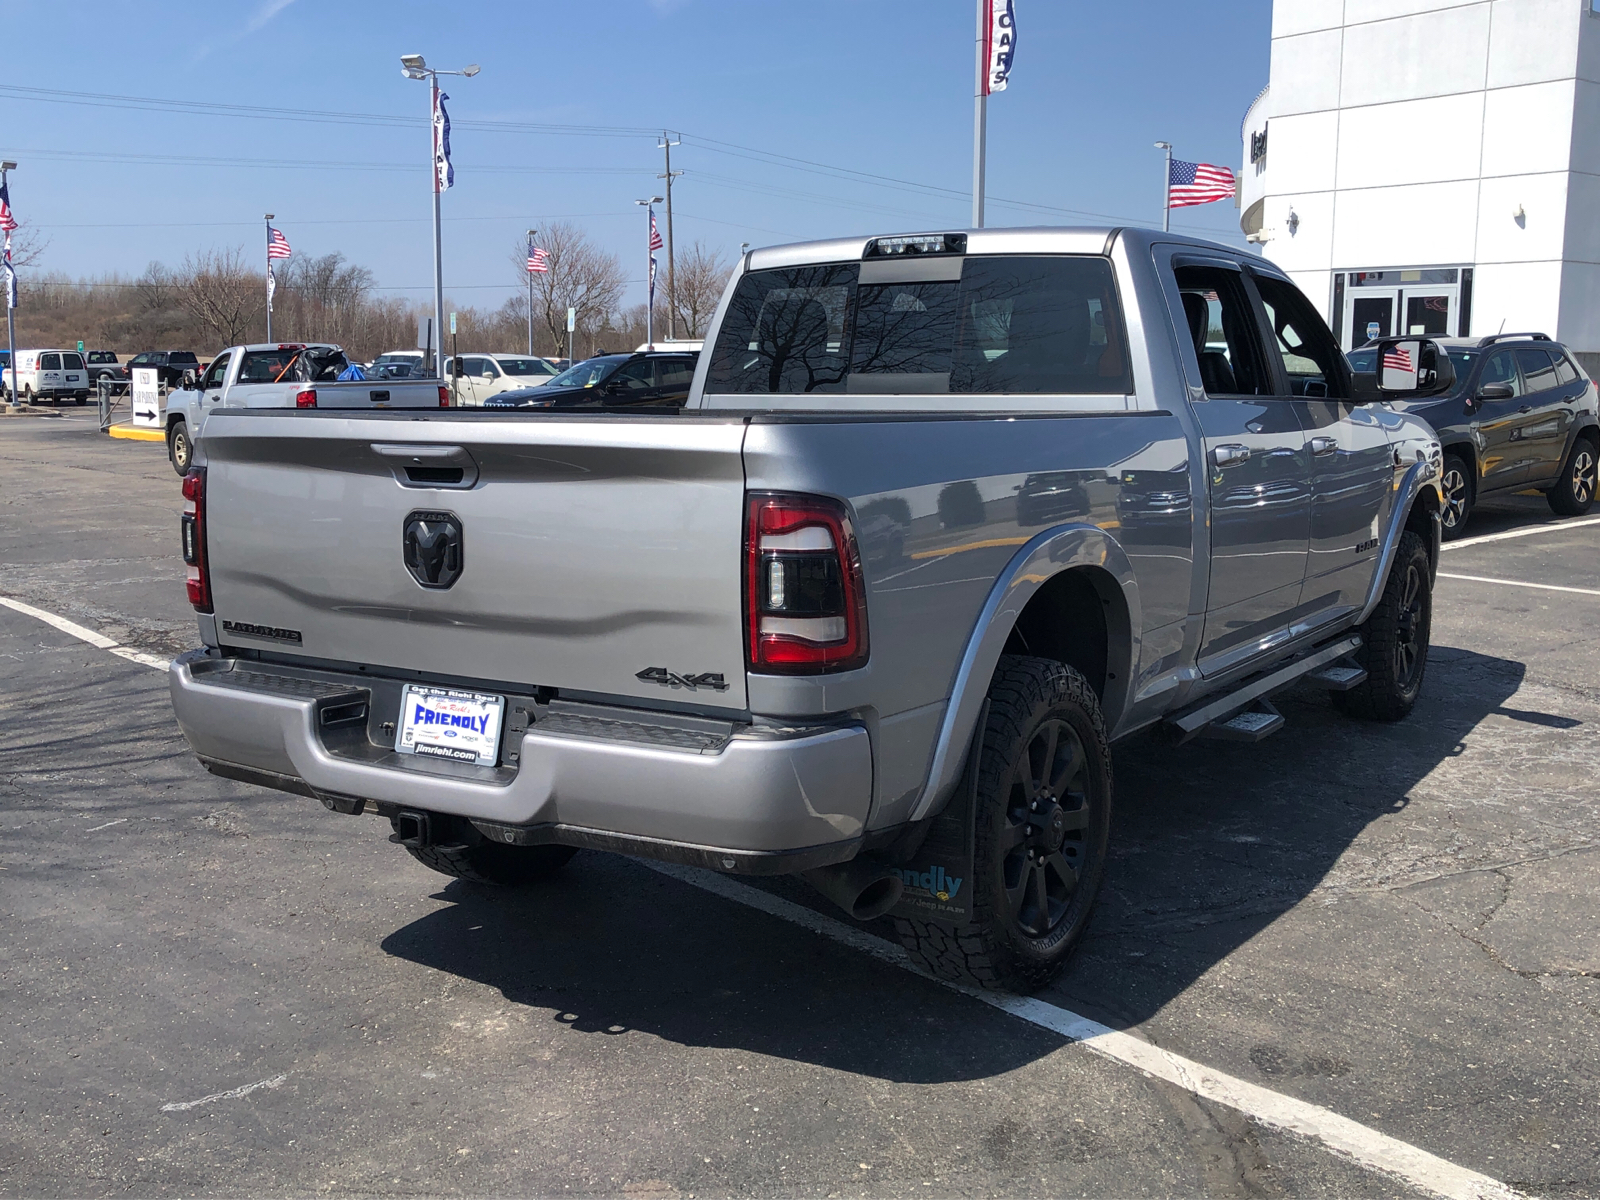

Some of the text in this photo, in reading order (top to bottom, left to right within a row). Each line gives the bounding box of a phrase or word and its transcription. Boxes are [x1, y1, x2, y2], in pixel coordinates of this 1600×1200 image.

[1355, 538, 1378, 553] RAM
[411, 686, 428, 694] Get
[430, 688, 446, 696] the
[448, 691, 472, 699] Riehl
[474, 694, 496, 702] Deal
[435, 702, 447, 711] Jim
[413, 703, 490, 735] FRIENDLY
[415, 744, 475, 760] jimriehl.com
